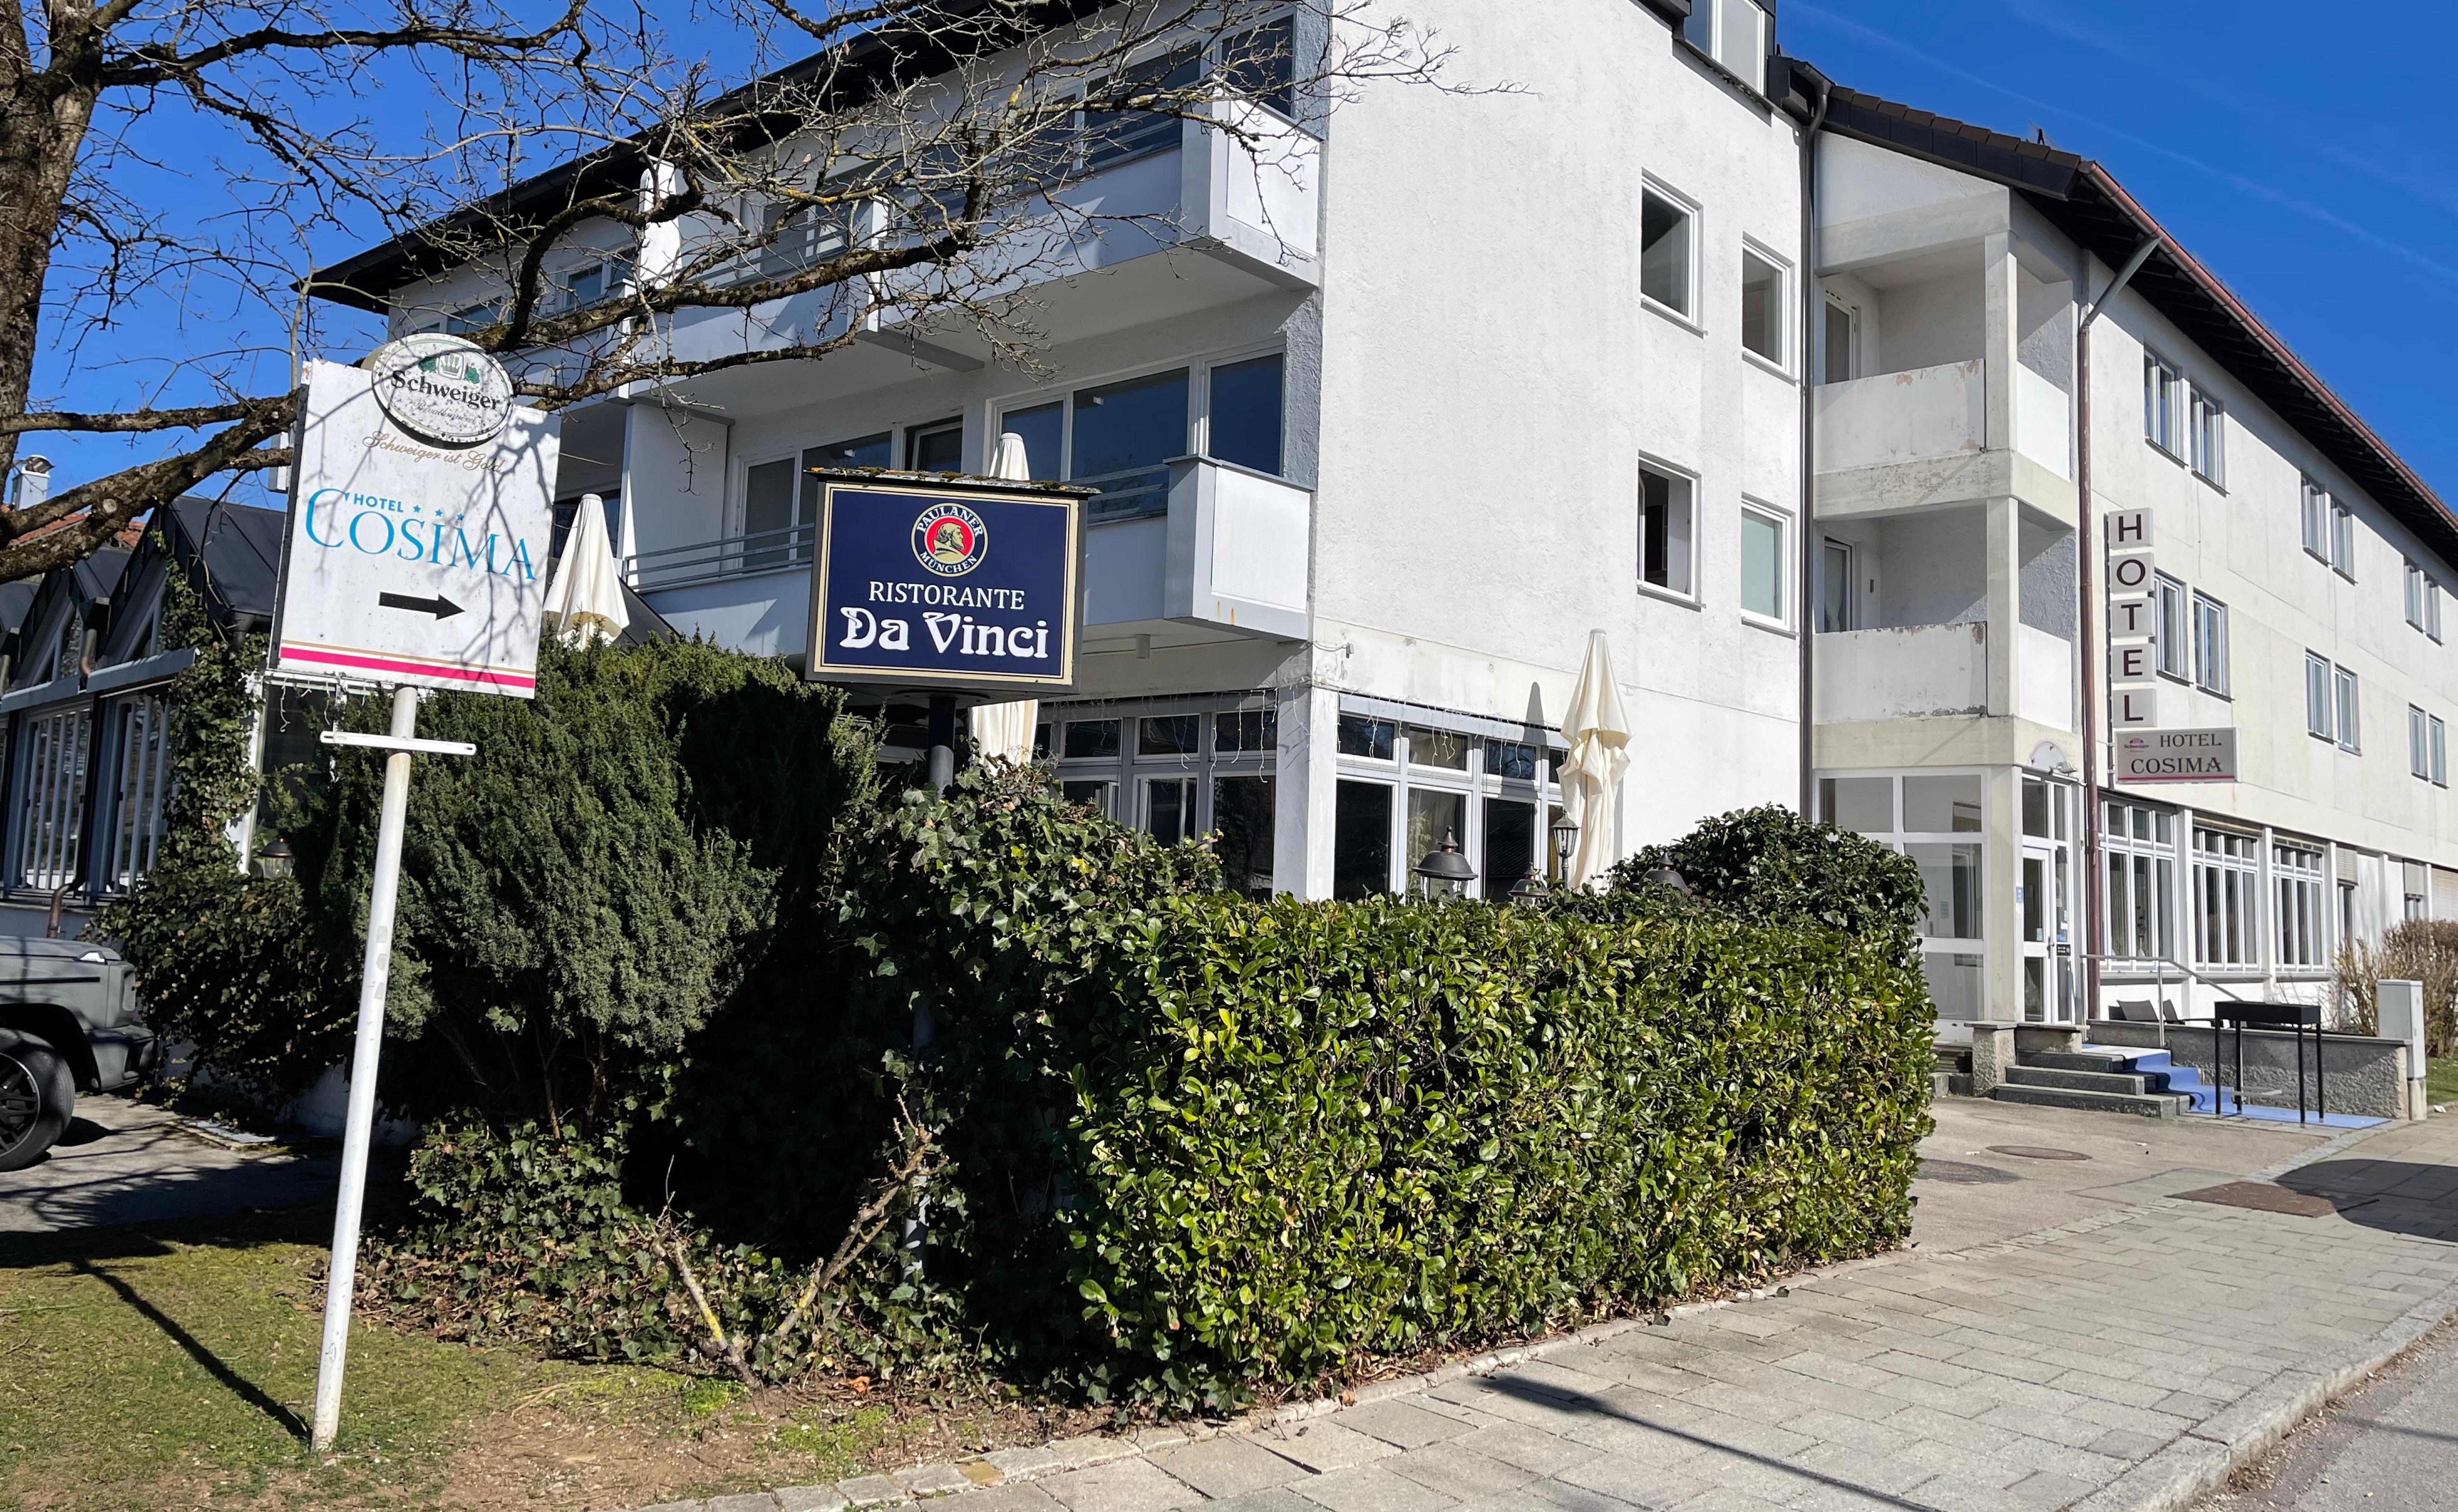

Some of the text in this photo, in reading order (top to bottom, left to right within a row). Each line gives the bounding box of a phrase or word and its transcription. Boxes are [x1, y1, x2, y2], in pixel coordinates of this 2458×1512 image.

[391, 370, 500, 411] Schweiger
[363, 431, 505, 472] Schweiger ist Gold
[353, 493, 404, 513] HOTEL
[305, 488, 536, 580] COSIMA
[917, 506, 983, 537] PAULANER
[920, 551, 977, 573] MÜNCHEN
[869, 581, 1025, 610] RISTORANTE
[839, 607, 1049, 658] Da Vinci
[2117, 514, 2145, 722] HOTEL
[2160, 733, 2222, 747] HOTEL
[2131, 757, 2223, 773] COSIMA
